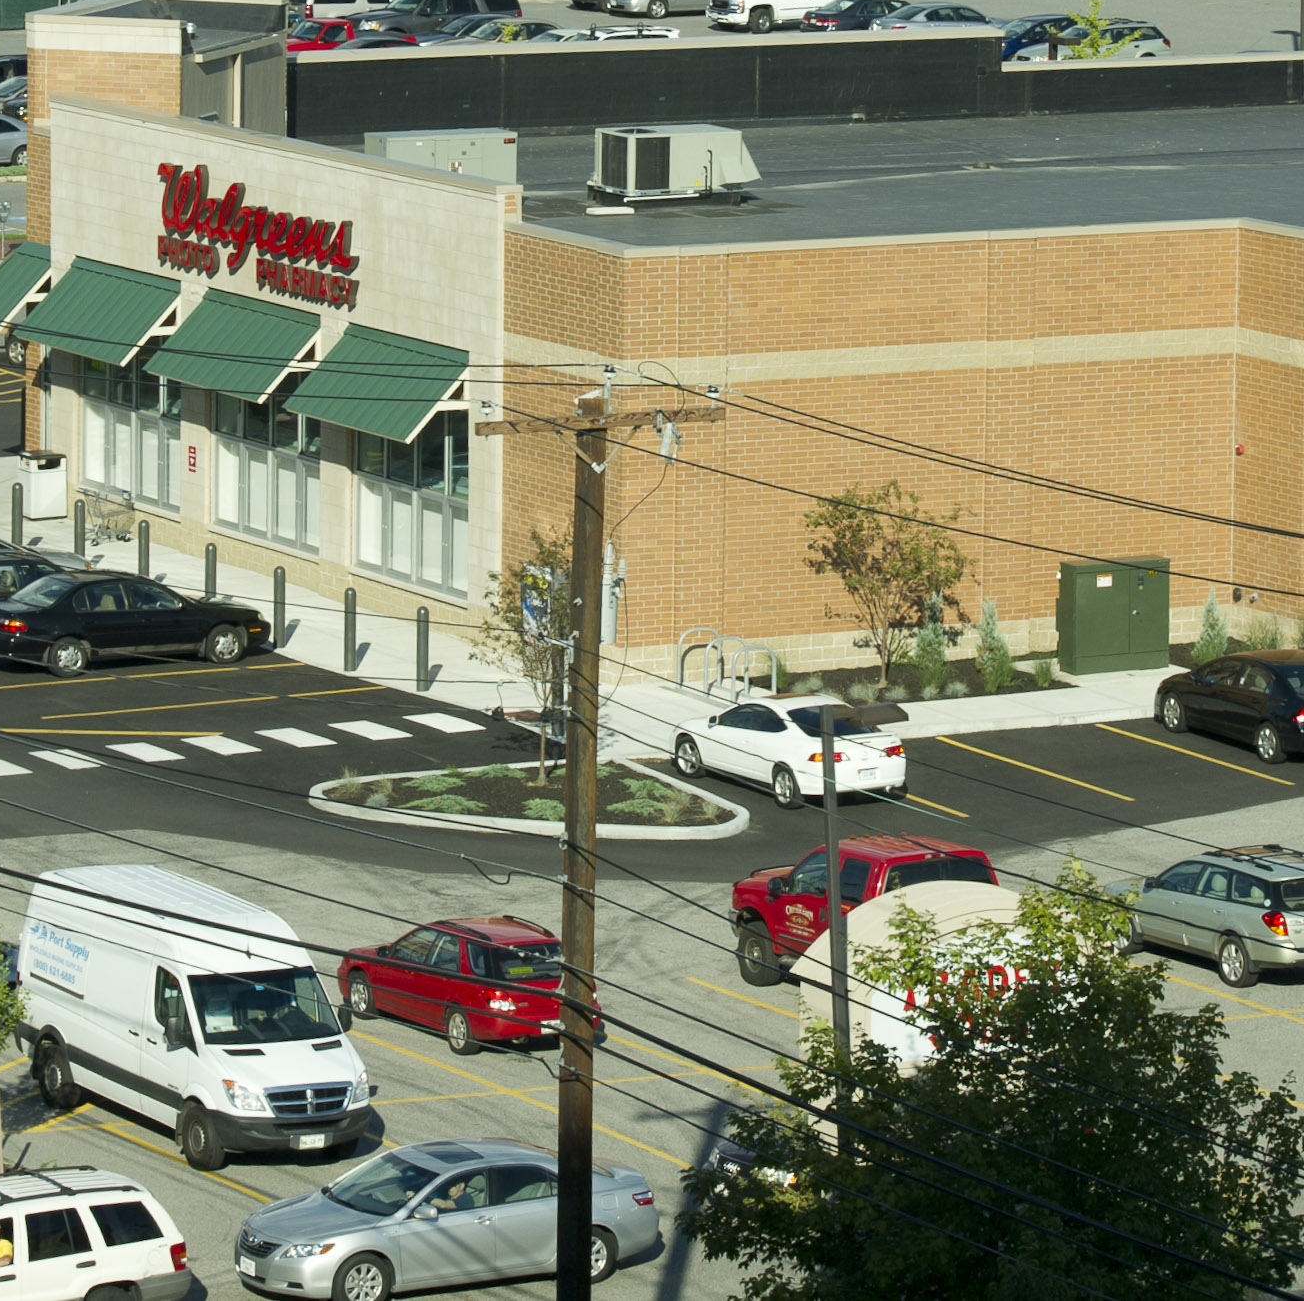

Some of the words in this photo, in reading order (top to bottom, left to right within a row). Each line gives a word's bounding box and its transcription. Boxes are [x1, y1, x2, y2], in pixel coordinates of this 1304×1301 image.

[157, 162, 360, 273] Walgreens
[157, 235, 220, 276] PHOTO
[256, 258, 359, 308] PHARMACY
[49, 930, 65, 947] Port
[65, 938, 90, 961] Supply
